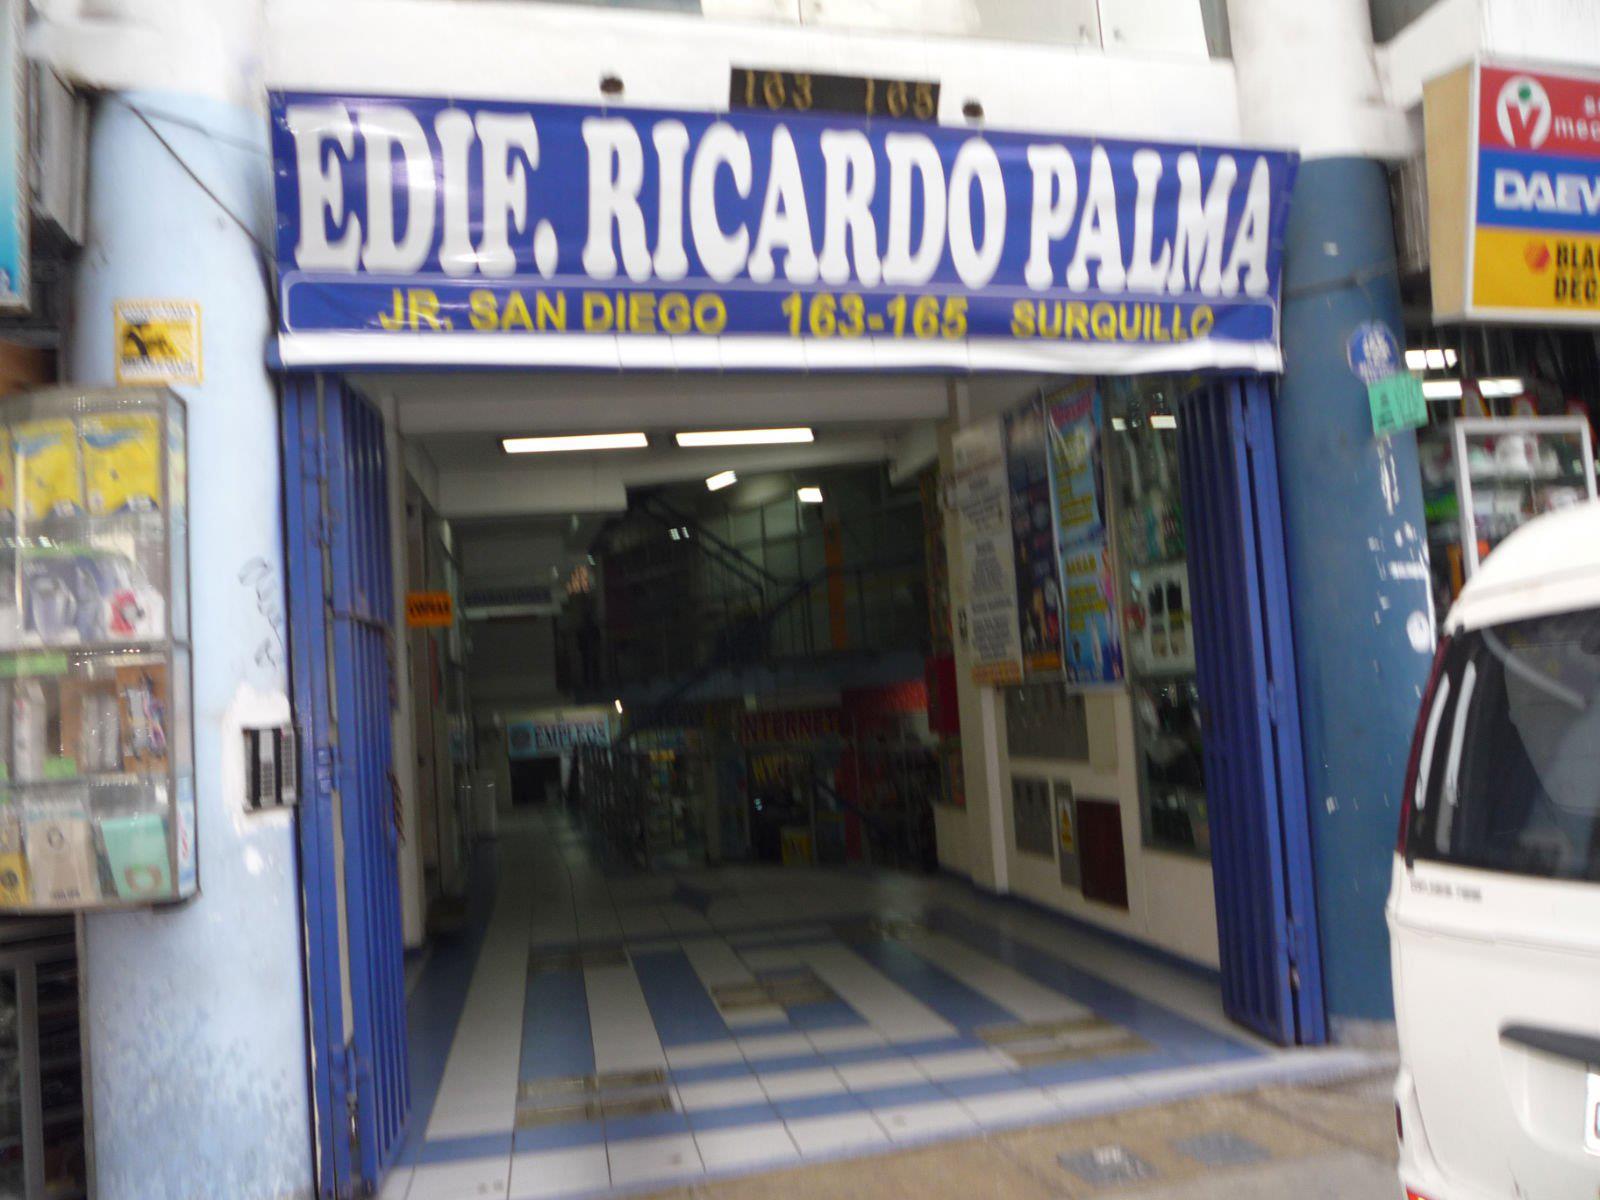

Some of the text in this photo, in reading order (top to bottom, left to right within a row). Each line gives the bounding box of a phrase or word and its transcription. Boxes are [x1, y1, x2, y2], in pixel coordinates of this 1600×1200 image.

[286, 103, 1271, 298] EDIF. RICARDO PALMA
[1556, 241, 1600, 269] BLA
[378, 288, 1215, 342] JR. SAN DIEGO 163-165 SURQUILLO
